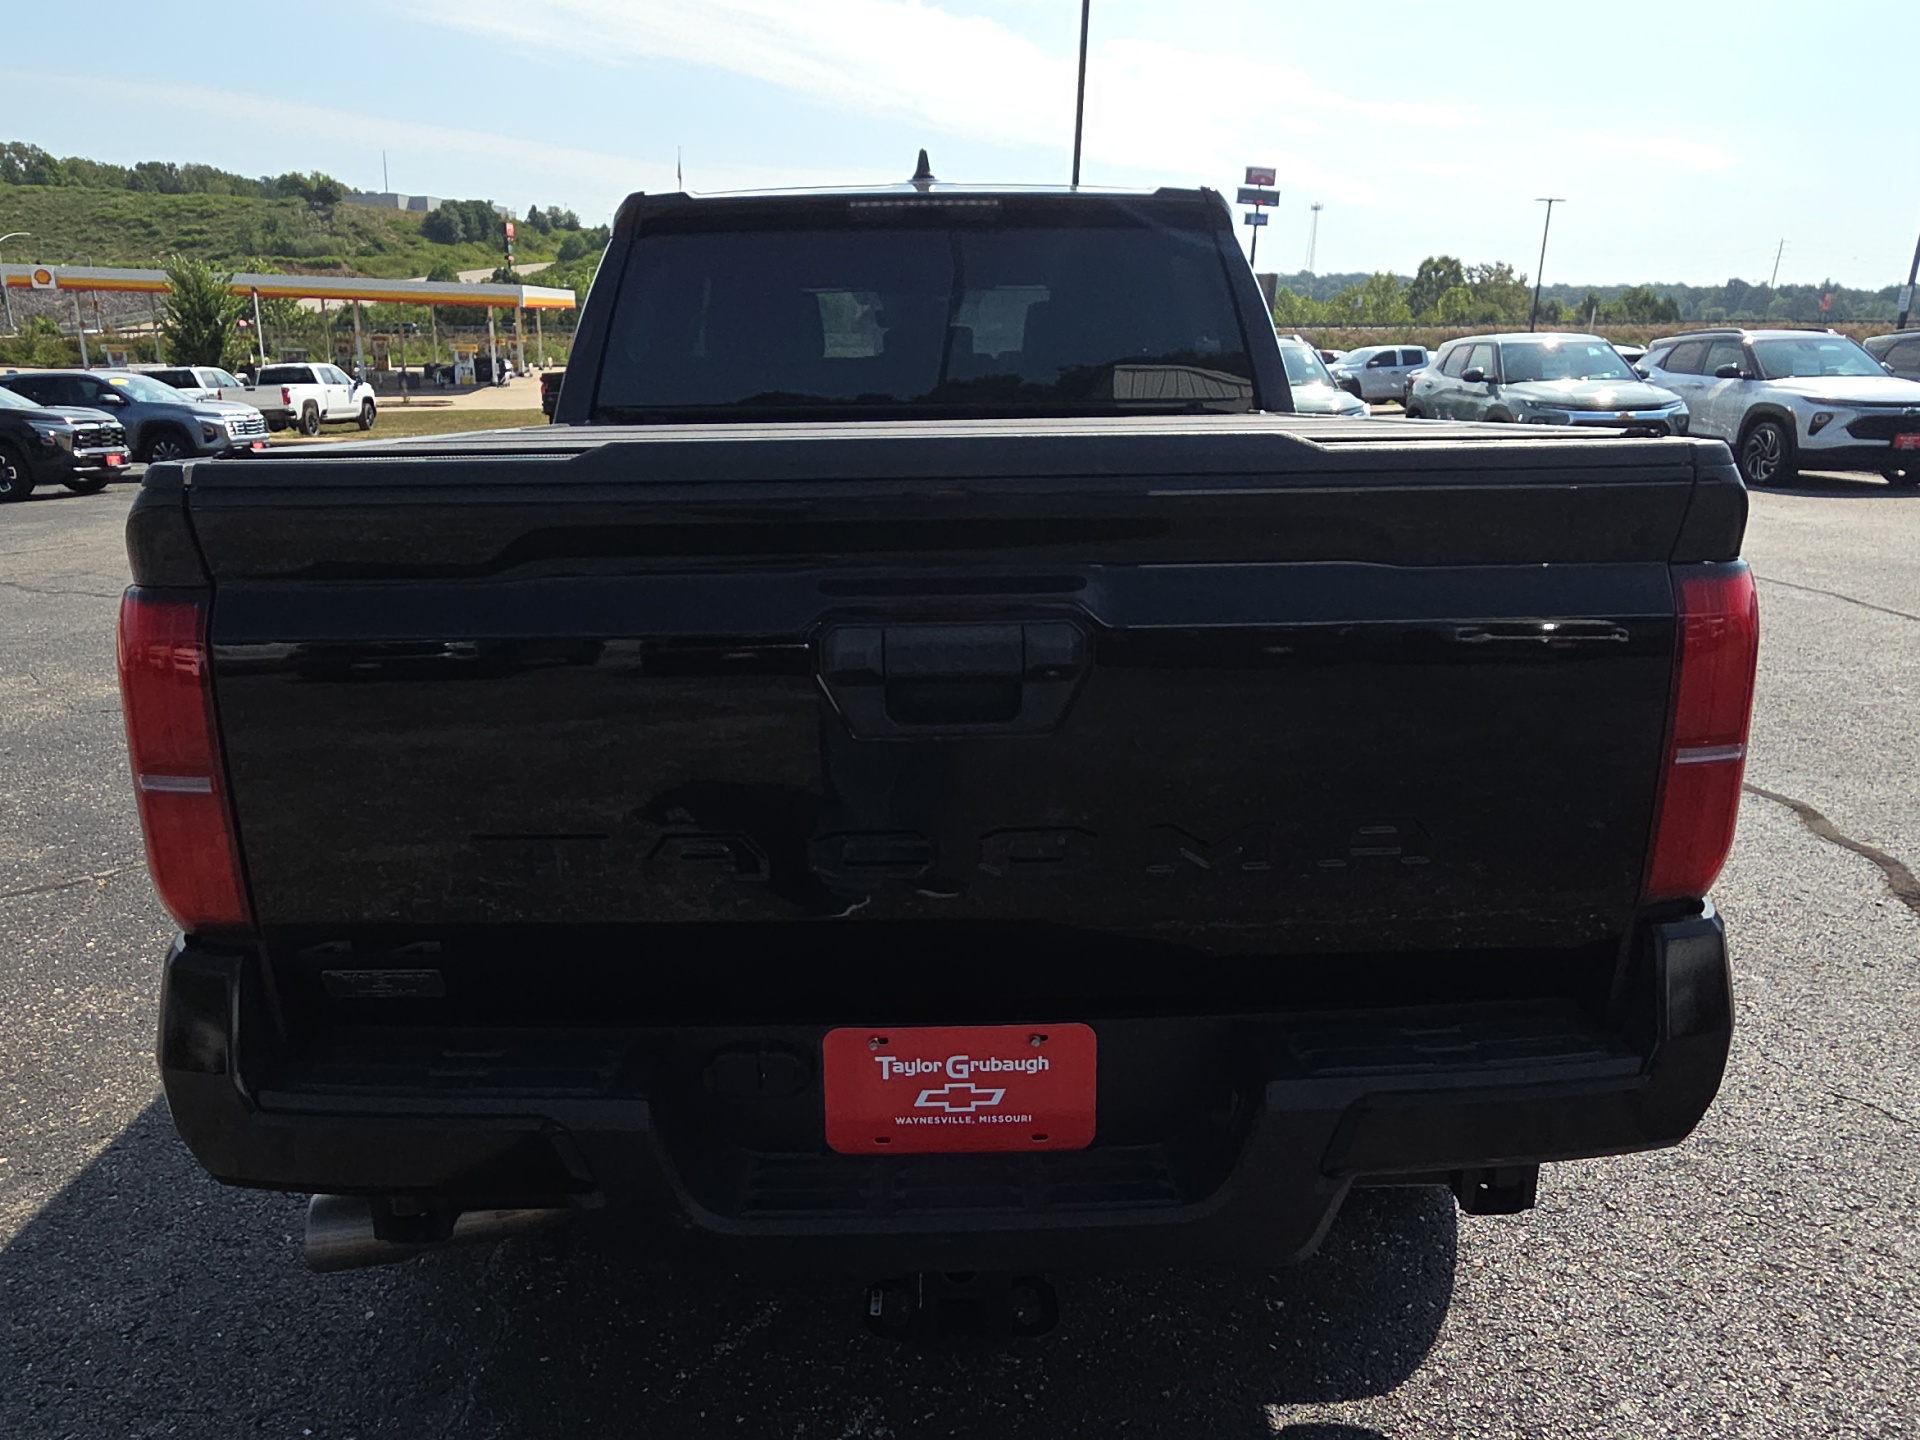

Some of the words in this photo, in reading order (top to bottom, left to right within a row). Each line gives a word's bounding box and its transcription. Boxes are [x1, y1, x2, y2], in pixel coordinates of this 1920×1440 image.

[471, 816, 1434, 884] TACOMA
[874, 1055, 943, 1080] Taylor
[945, 1054, 1050, 1079] Grubaugh
[895, 1115, 976, 1125] WAYNESVILLE,
[978, 1114, 1032, 1124] MISSOURI
